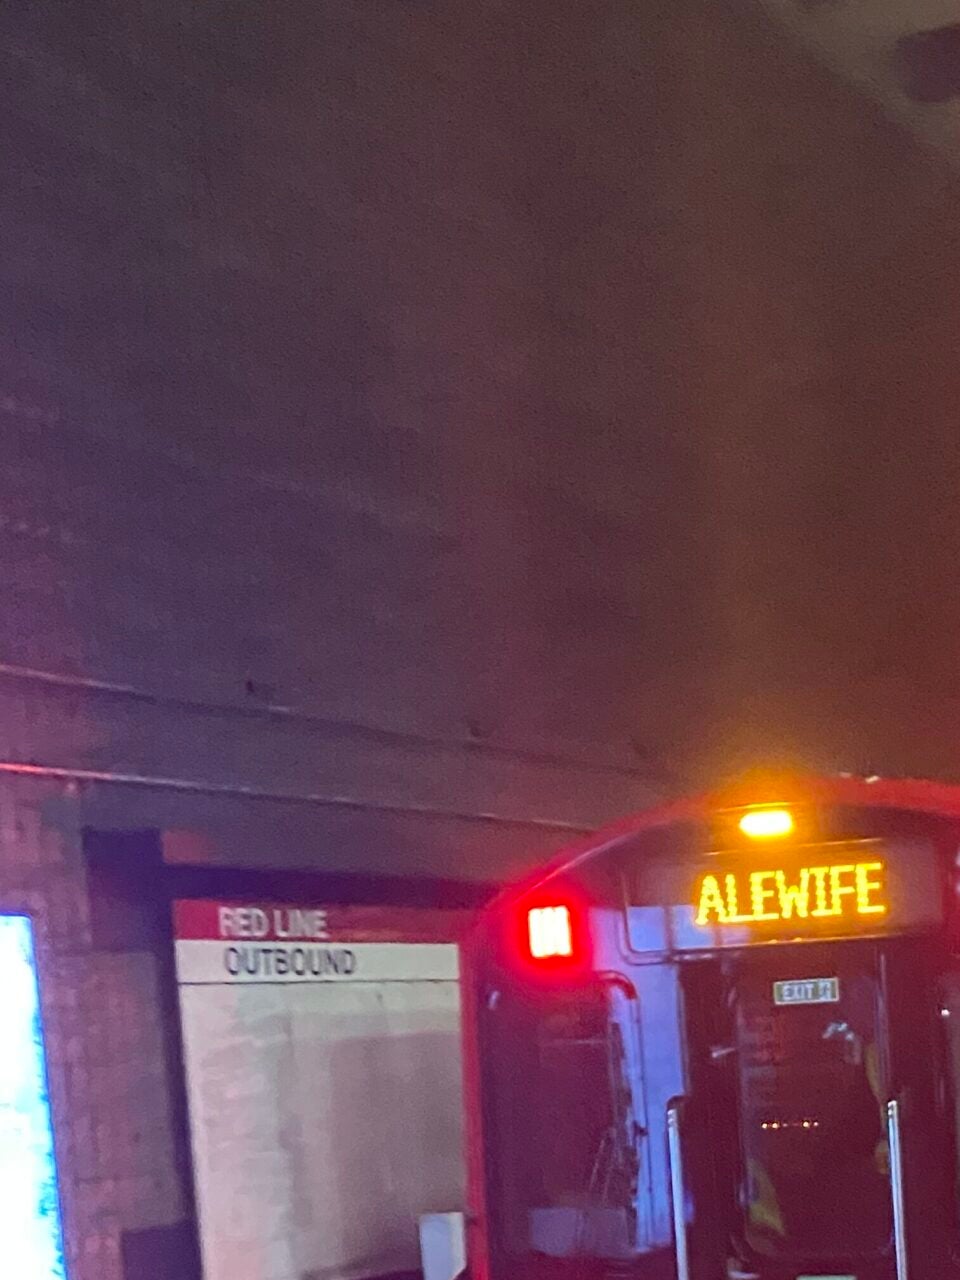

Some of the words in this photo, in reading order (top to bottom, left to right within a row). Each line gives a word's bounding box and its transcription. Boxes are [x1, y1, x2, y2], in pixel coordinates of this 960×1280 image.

[695, 862, 885, 925] ALEWIFE
[218, 906, 269, 936] RED
[273, 908, 329, 938] LINE
[223, 947, 356, 975] OUTBOUND
[782, 984, 814, 1001] EXIT
